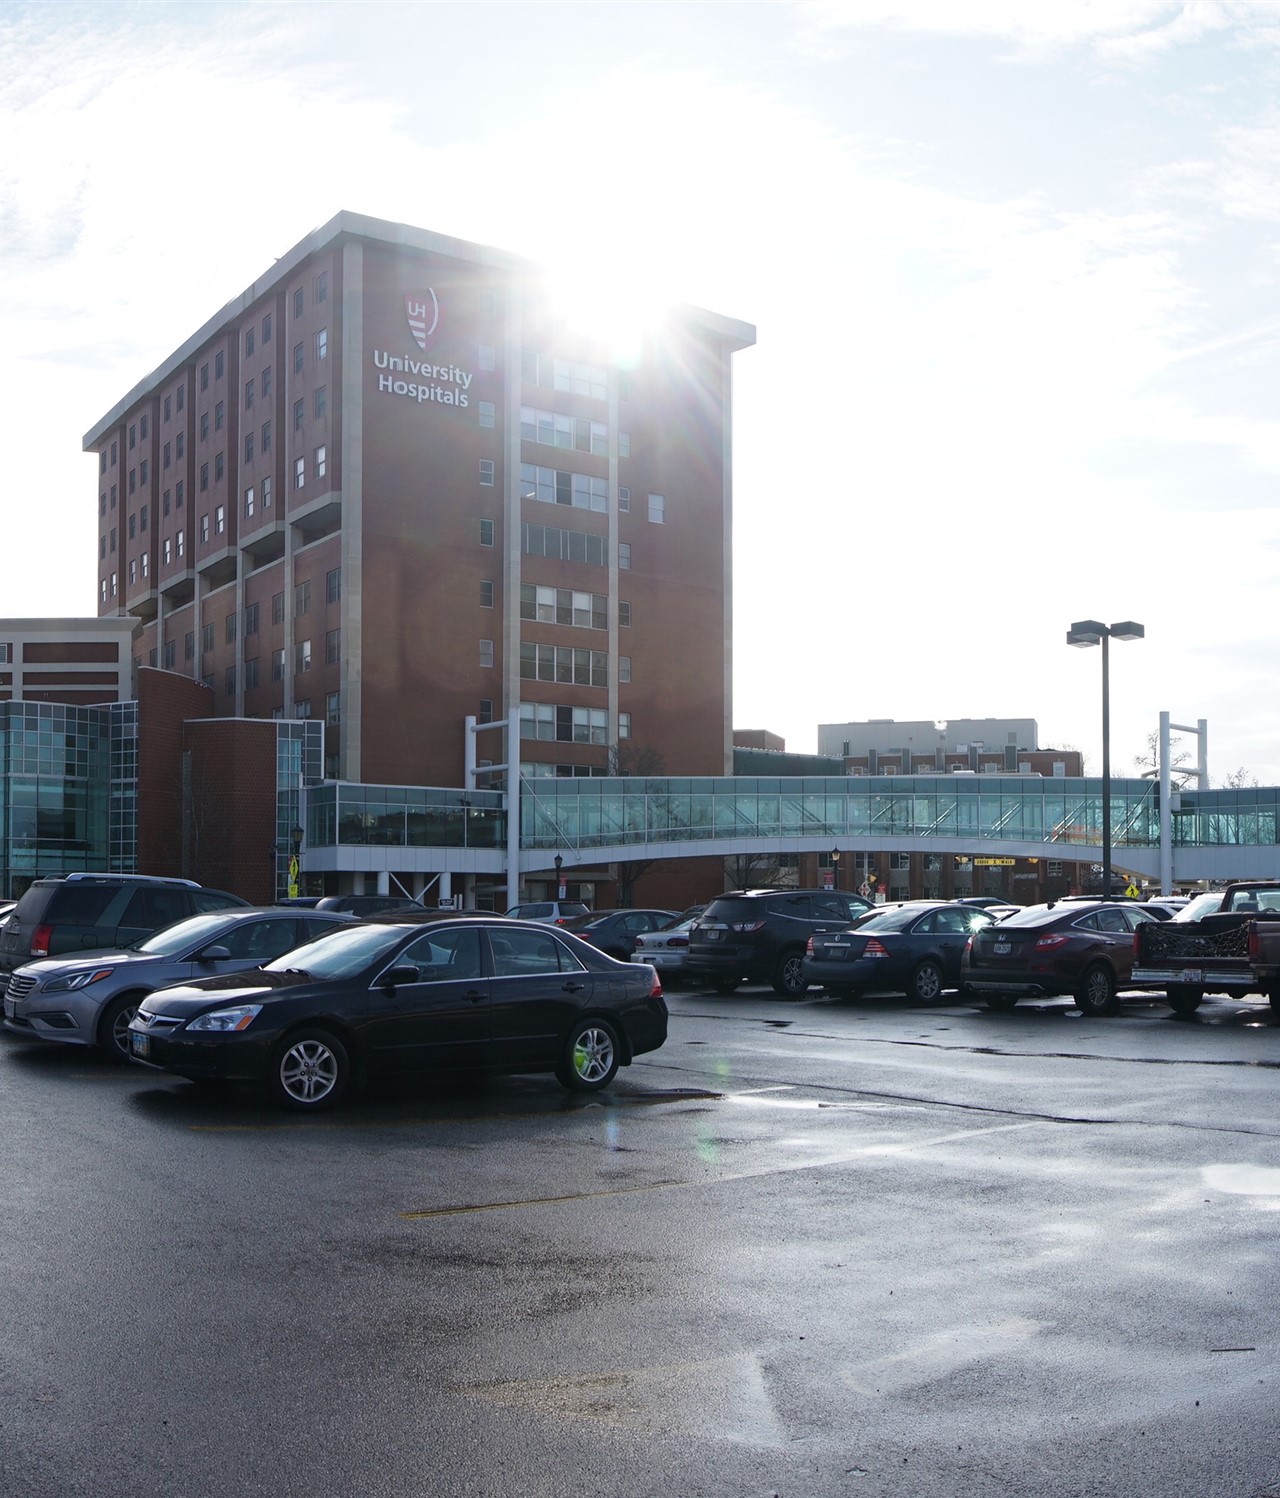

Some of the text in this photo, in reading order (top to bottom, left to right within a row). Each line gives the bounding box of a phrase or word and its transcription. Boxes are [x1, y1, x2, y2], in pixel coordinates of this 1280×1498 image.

[408, 301, 426, 318] UH
[373, 350, 472, 389] University
[378, 374, 469, 408] Hospitals
